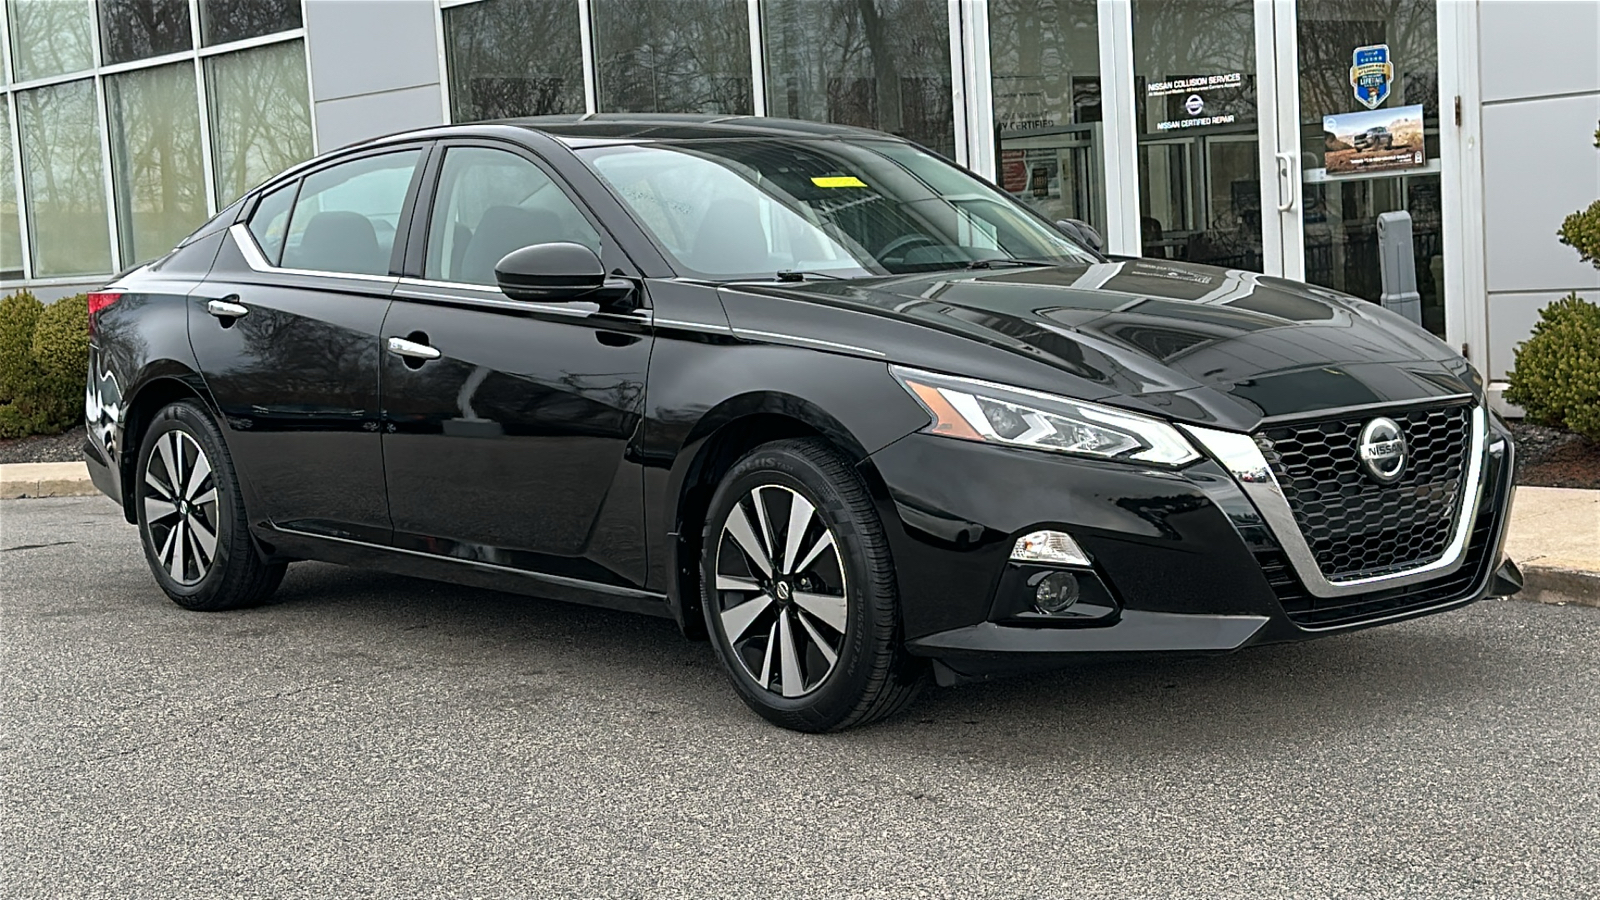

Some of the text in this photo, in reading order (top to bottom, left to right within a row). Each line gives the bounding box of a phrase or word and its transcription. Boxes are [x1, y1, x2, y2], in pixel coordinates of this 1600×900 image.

[1147, 73, 1240, 91] NISSAN COLLISION SERVICES
[1010, 119, 1054, 131] CERTIFIED
[1156, 114, 1235, 130] NISSAN CERTIFIED REPAIR
[1368, 441, 1403, 456] NISSAN
